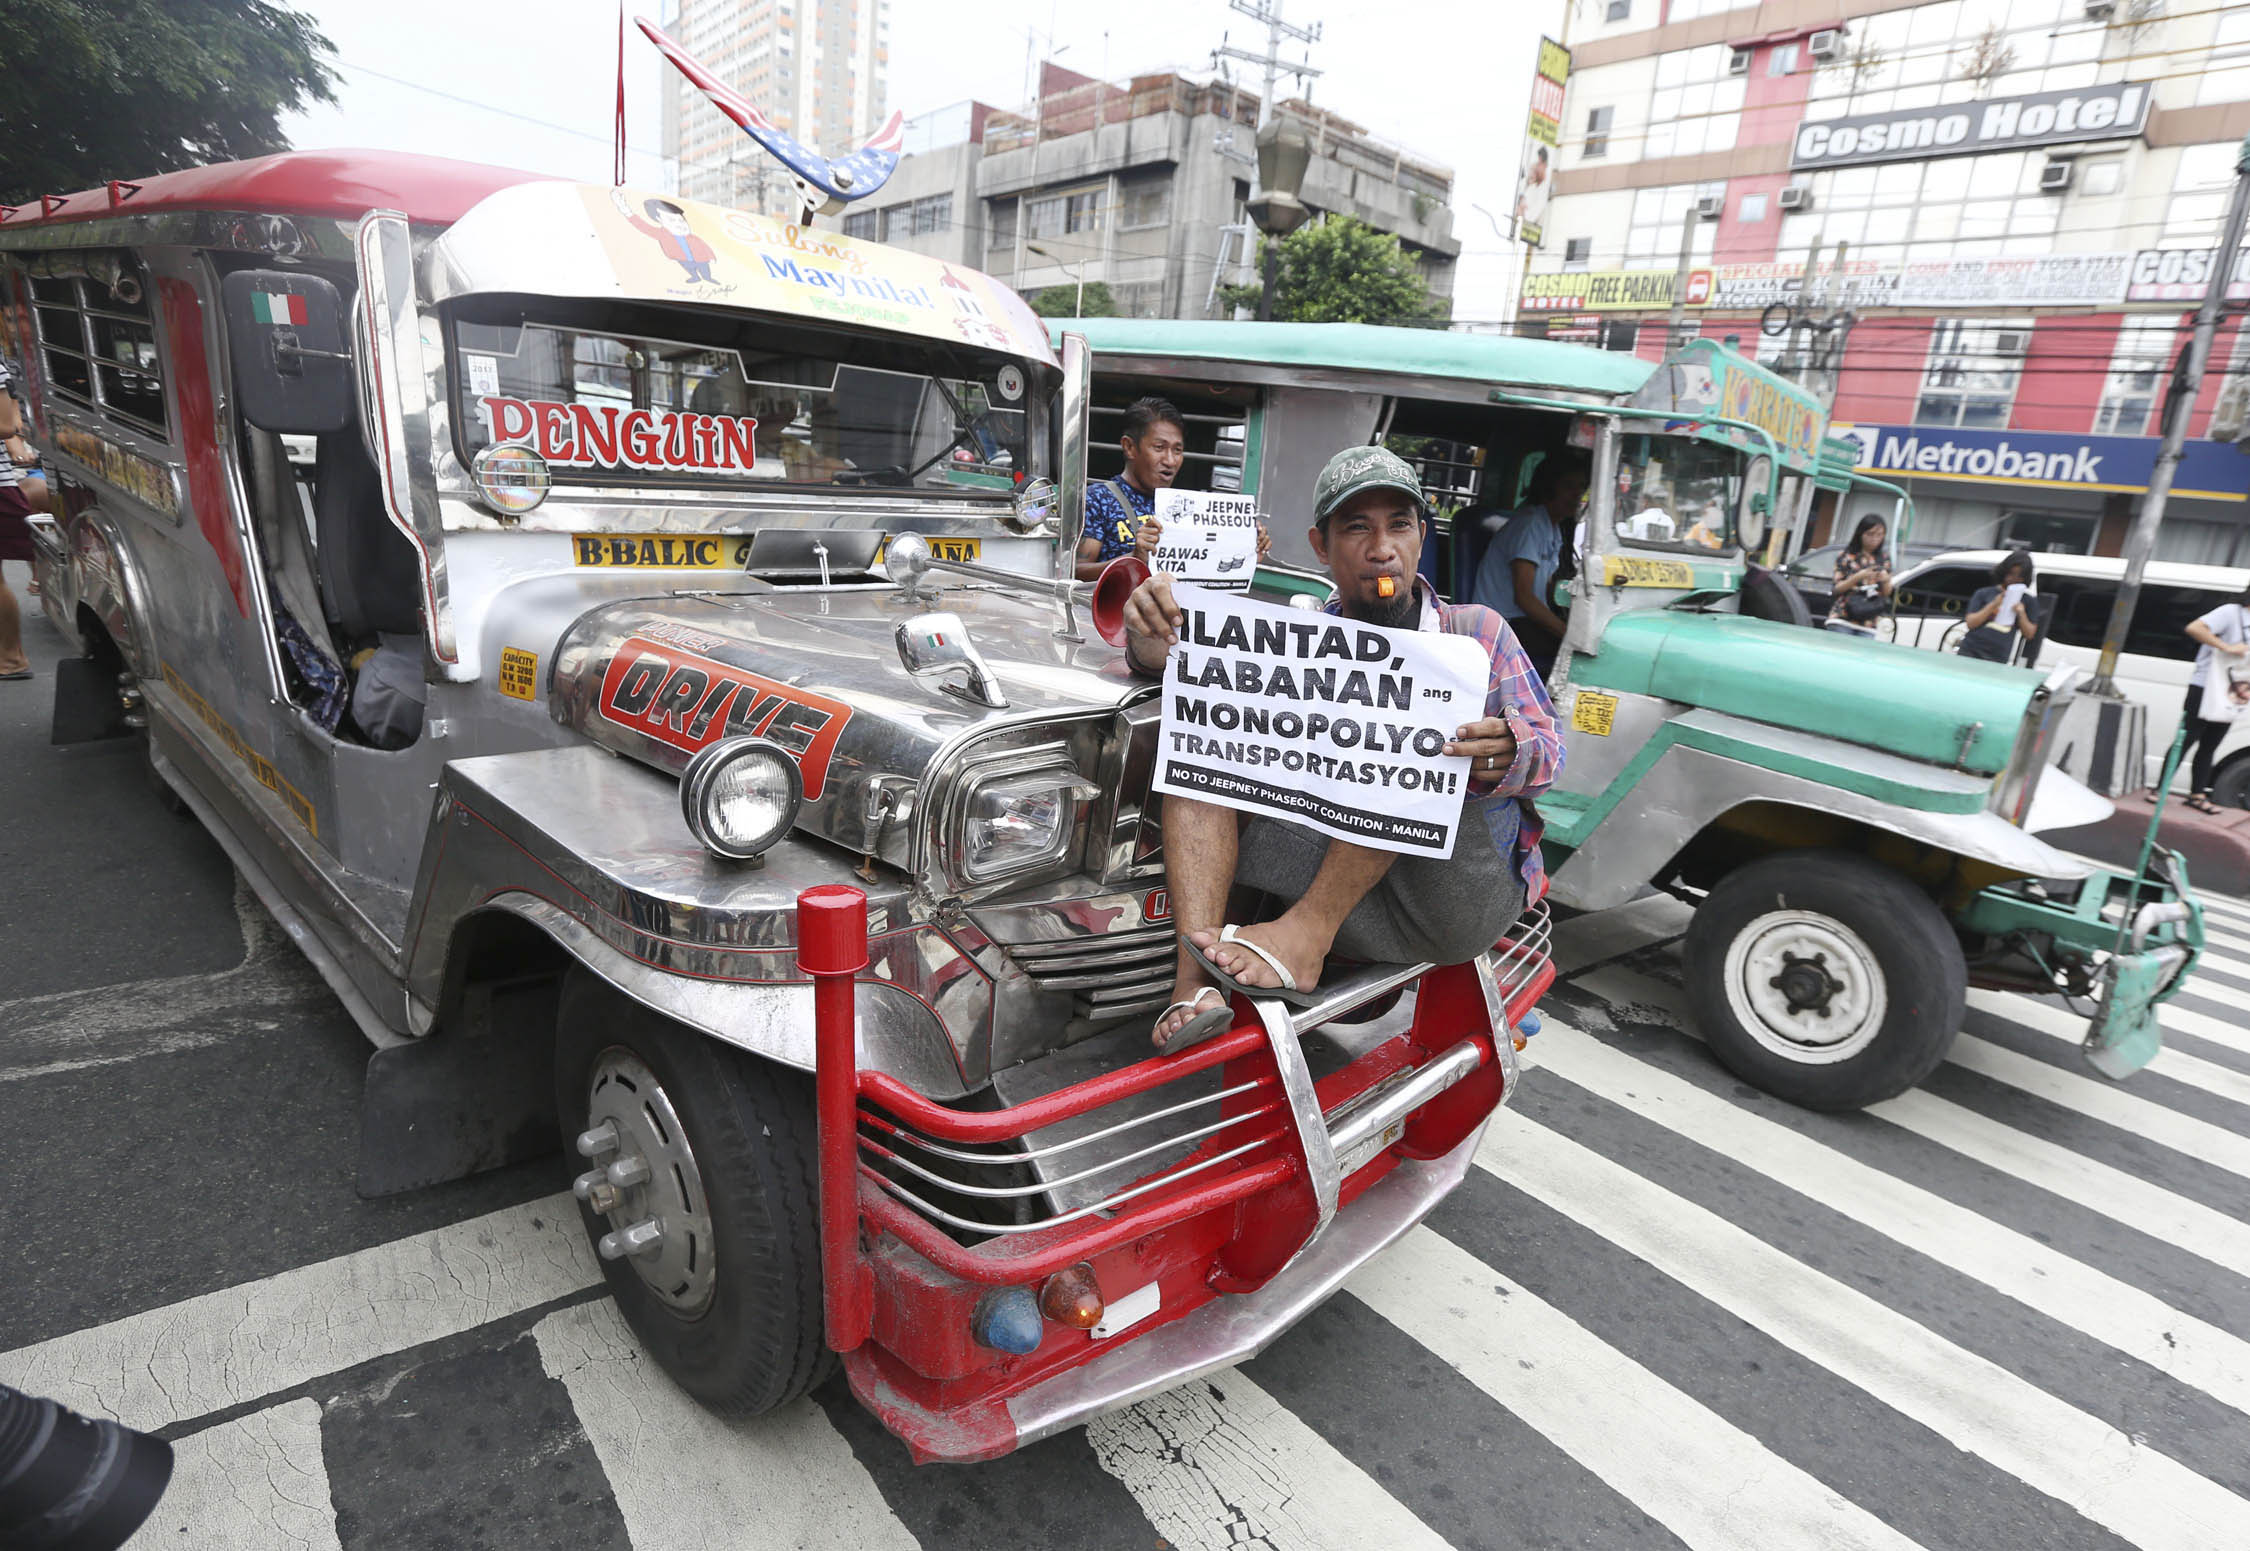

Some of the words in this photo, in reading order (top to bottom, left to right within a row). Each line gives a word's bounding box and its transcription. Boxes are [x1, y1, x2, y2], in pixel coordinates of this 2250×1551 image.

[1797, 114, 1970, 160] Cosmo
[1978, 86, 2144, 141] Hotel
[724, 213, 869, 275] Sulong
[760, 253, 936, 310] Maynila!
[1523, 297, 1581, 309] HOTEL
[1524, 273, 1588, 297] COSMO
[1589, 276, 1620, 303] FREE
[1622, 273, 1678, 302] PARKIN
[1880, 435, 2104, 483] Metrobank
[1193, 513, 1257, 529] PHASEOUT
[1156, 559, 1187, 573] KITA
[1157, 546, 1209, 560] BAWAS
[1179, 606, 1405, 671] ILANTAD,
[610, 651, 834, 765] DRIVE
[1422, 686, 1453, 702] ang
[1175, 695, 1446, 758] MONOPOLYO
[1169, 731, 1458, 796] TRANSPORTASYON!
[1171, 767, 1192, 781] NO
[1192, 770, 1208, 785] TO
[1209, 774, 1259, 797] JEEPNEY
[1260, 788, 1320, 814] PHASEOUT
[1320, 806, 1383, 832] COALITION
[1392, 822, 1441, 842] MANILA
